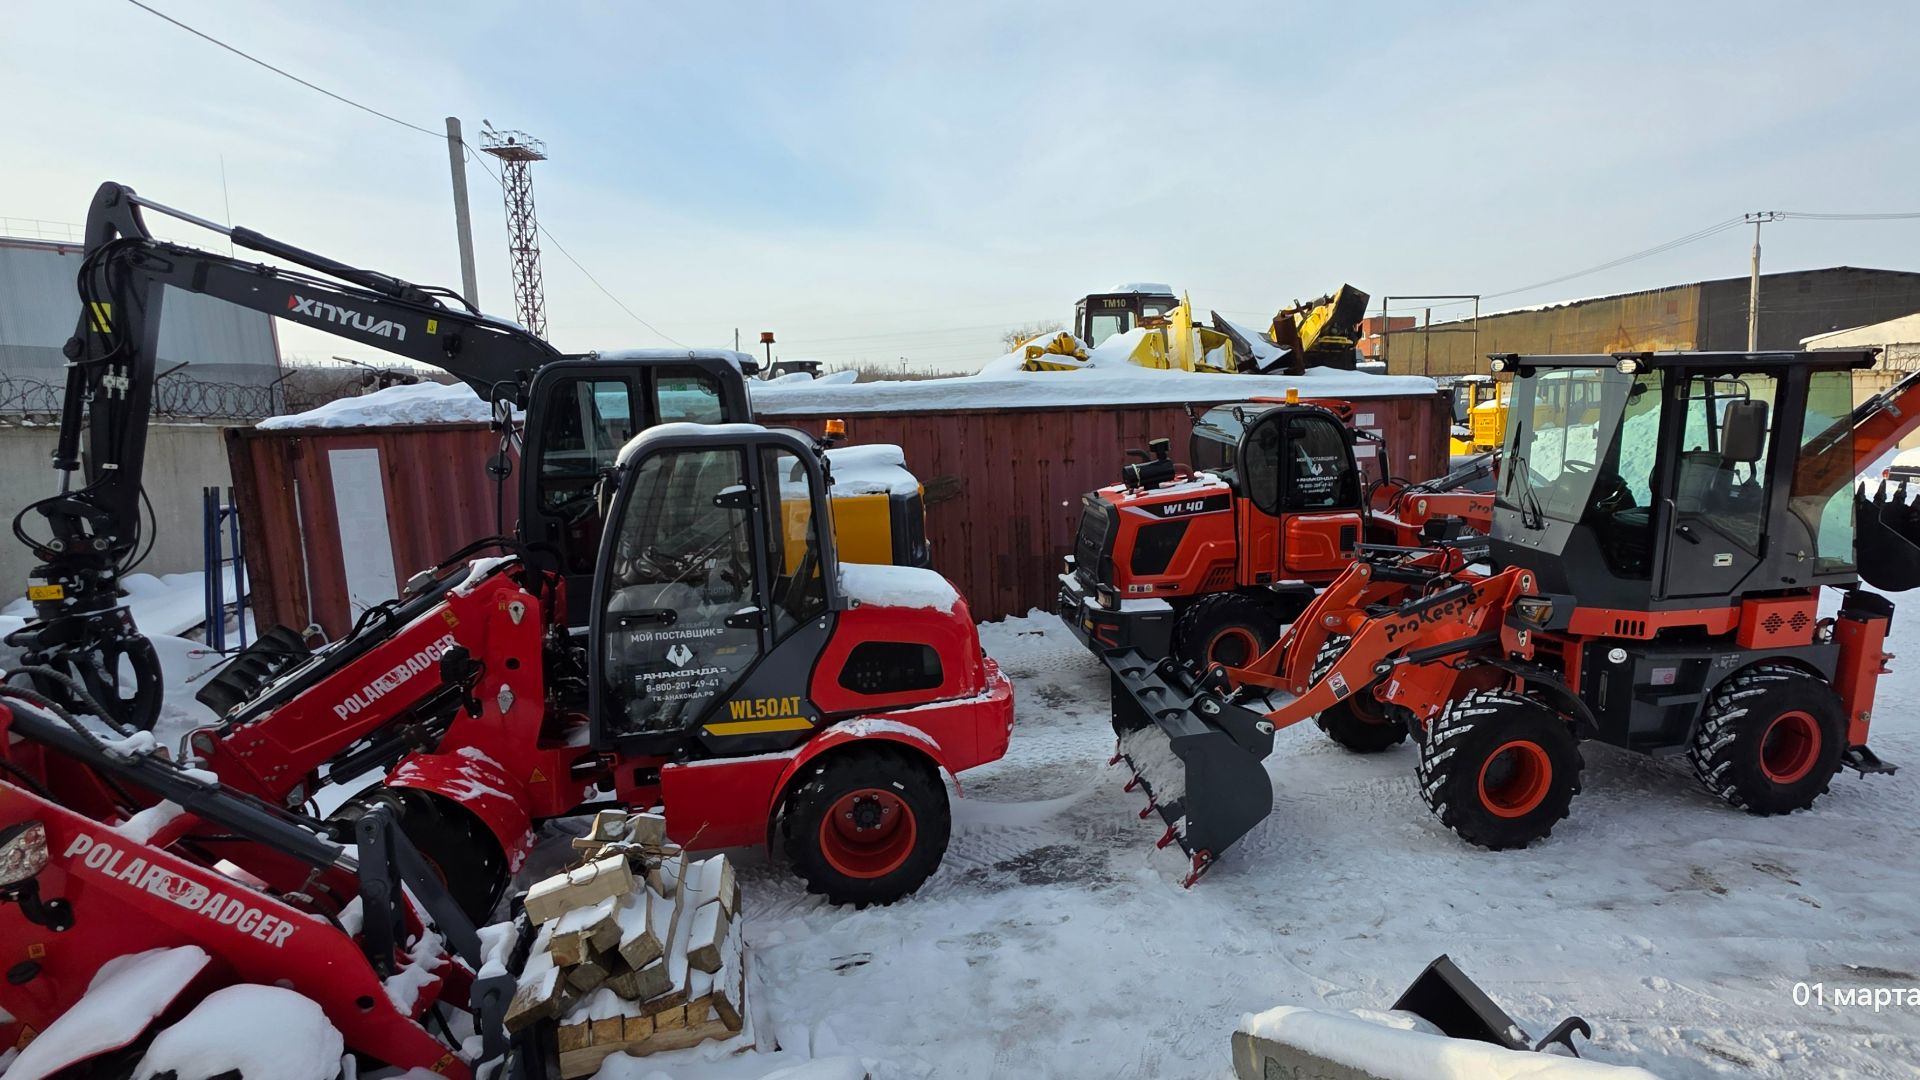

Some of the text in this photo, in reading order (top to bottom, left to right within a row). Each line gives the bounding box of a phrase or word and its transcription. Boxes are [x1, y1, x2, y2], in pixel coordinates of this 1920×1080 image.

[1468, 500, 1494, 513] Pro
[630, 627, 717, 643] МОЙ ПОСТАВЩИК
[646, 678, 719, 693] 8-800-201-49-41
[333, 674, 388, 721] POLAR
[729, 696, 801, 719] WL50AT
[63, 833, 294, 948] POLAR BADGER
